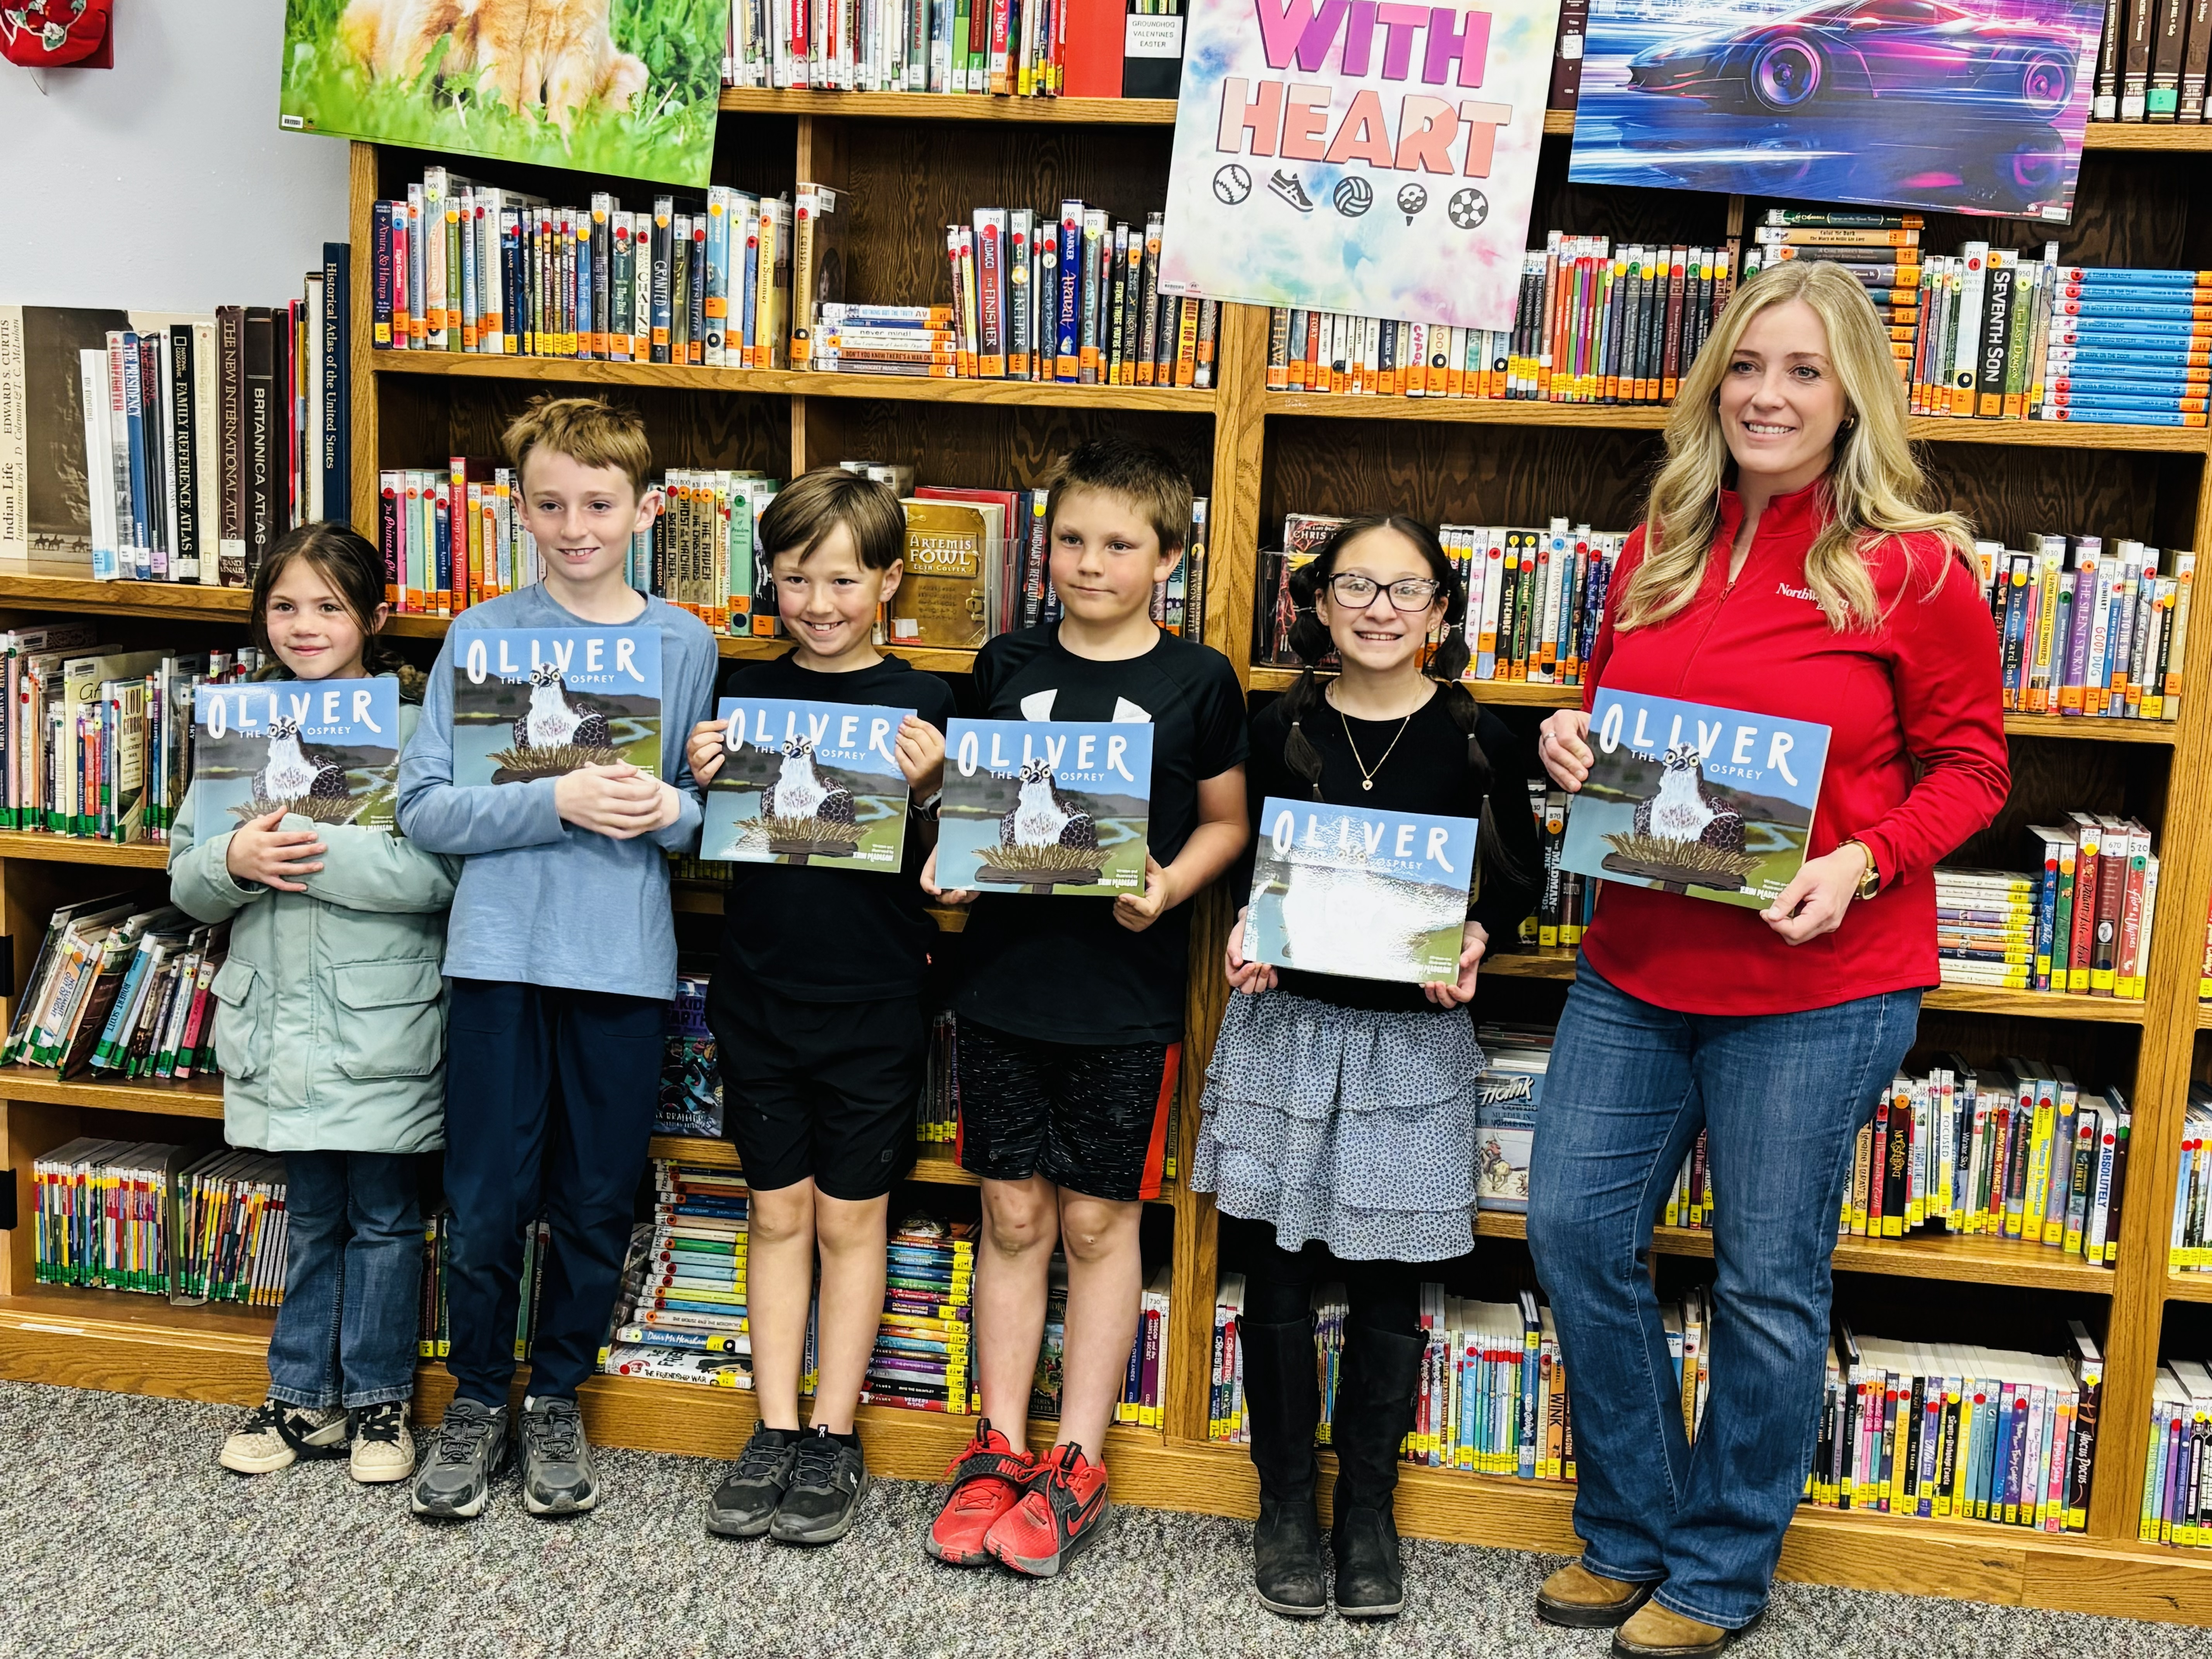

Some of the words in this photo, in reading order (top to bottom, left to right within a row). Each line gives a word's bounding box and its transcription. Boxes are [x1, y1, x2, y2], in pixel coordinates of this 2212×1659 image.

[995, 11, 1007, 43] Night
[1255, 0, 1492, 88] WITH
[1216, 77, 1513, 178] HEART
[489, 238, 497, 283] Westmark
[764, 235, 772, 265] Frozen
[1066, 230, 1075, 260] BARKER
[326, 263, 337, 321] Historical
[654, 260, 668, 306] GRANTED
[762, 267, 771, 304] Summer
[1115, 281, 1124, 304] STRIKE
[637, 272, 649, 339] CHAINS
[985, 290, 997, 347] FINISHER
[1114, 306, 1123, 325] THREE
[1989, 271, 2011, 344] SEVENTH
[224, 321, 235, 348] THE
[326, 323, 337, 352] Atlas
[1013, 298, 1025, 347] KEEPER
[1113, 326, 1122, 348] YOU'RE
[1128, 314, 1136, 334] IRON
[1163, 325, 1173, 344] KEY
[1, 320, 10, 365] CURTIS
[1412, 325, 1423, 367] CHAOS
[225, 350, 236, 383] NEW
[326, 355, 337, 367] of
[1985, 347, 2004, 382] SON
[125, 364, 141, 418] PRESIDENCY
[326, 370, 337, 389] the
[3, 383, 12, 434] EDWARD
[177, 382, 189, 428] FAMILY
[326, 392, 337, 432] United
[14, 403, 22, 441] Coleman
[254, 388, 266, 486] BRITANNICA
[167, 435, 176, 476] CROSSING
[225, 385, 237, 496] INTERNATIONAL
[326, 435, 337, 469] States
[2, 462, 14, 491] Life
[177, 431, 191, 508] REFERENCE
[169, 479, 177, 508] ALASKA
[3, 496, 14, 541] Indian
[15, 485, 24, 541] Introductions
[225, 497, 238, 539] ATLAS
[255, 491, 266, 545] ATLAS
[452, 516, 462, 533] Top
[180, 511, 192, 551] ATLAS
[384, 516, 395, 558] Princess
[702, 519, 711, 539] THE
[910, 534, 972, 550] ARTEMIS
[1293, 530, 1327, 540] CHRIS
[910, 548, 971, 566] FOWL
[1030, 524, 1043, 566] HANGMAN'S
[385, 559, 395, 580] Plot
[667, 552, 677, 578] CREEK
[680, 540, 690, 583] MACHINE
[702, 542, 711, 581] RAVEN
[1026, 568, 1040, 615] REVOLUTION
[2047, 578, 2056, 594] FROM
[2080, 579, 2091, 599] THE
[1503, 608, 1513, 636] EMBER
[1550, 601, 1558, 613] HILL
[2076, 602, 2090, 637] SILENT
[2123, 595, 2133, 618] GOING
[2006, 610, 2021, 661] Graveyard
[2094, 627, 2106, 653] GOOD
[2120, 631, 2130, 643] THE
[2121, 620, 2131, 629] TO
[466, 638, 646, 685] OLIVER
[2040, 632, 2049, 660] NOWHERE
[2071, 640, 2085, 675] STORM
[2118, 645, 2129, 659] SUN
[500, 675, 522, 686] THE
[570, 673, 615, 685] OSPREY
[125, 688, 141, 715] LOU
[207, 689, 381, 740] OLIVER
[239, 730, 261, 739] THE
[307, 725, 352, 736] OSPREY
[726, 708, 895, 764] OLIVER
[1599, 703, 1798, 787] OLIVER
[754, 744, 776, 754] THE
[821, 749, 866, 761] OSPREY
[957, 730, 1135, 782] OLIVER
[1631, 749, 1656, 763] THE
[1710, 763, 1763, 781] OSPREY
[990, 769, 1013, 780] THE
[1060, 771, 1106, 783] OSPREY
[1272, 810, 1454, 873] OLIVER
[2130, 842, 2148, 852] 520
[1370, 857, 1423, 871] OSPREY
[1549, 851, 1560, 906] MADMAN
[2127, 888, 2142, 912] Flora
[61, 972, 71, 986] OUT
[67, 977, 76, 989] NO
[50, 996, 62, 1018] SIGHT
[57, 991, 72, 1017] SUMMIT
[114, 982, 131, 1010] ROBERT
[106, 1010, 120, 1033] SCOTT
[1477, 1075, 1535, 1106] Hank
[1942, 1116, 1950, 1157] FOCUSED
[1961, 1132, 1970, 1155] Winter
[1995, 1127, 2006, 1162] MOVING
[2038, 1138, 2050, 1166] Welcome
[1960, 1156, 1969, 1168] Sky
[2098, 1147, 2112, 1208] ABSOLUTELY
[1993, 1163, 2002, 1195] TARGET
[2033, 1178, 2046, 1216] Wonderland
[647, 1331, 665, 1342] Dear
[645, 1369, 655, 1377] THE
[656, 1370, 690, 1381] FRIENDSHIP
[691, 1374, 706, 1384] WAR
[1550, 1393, 1565, 1427] WINK
[1898, 1418, 1908, 1432] Pay
[1895, 1441, 1906, 1472] Forward
